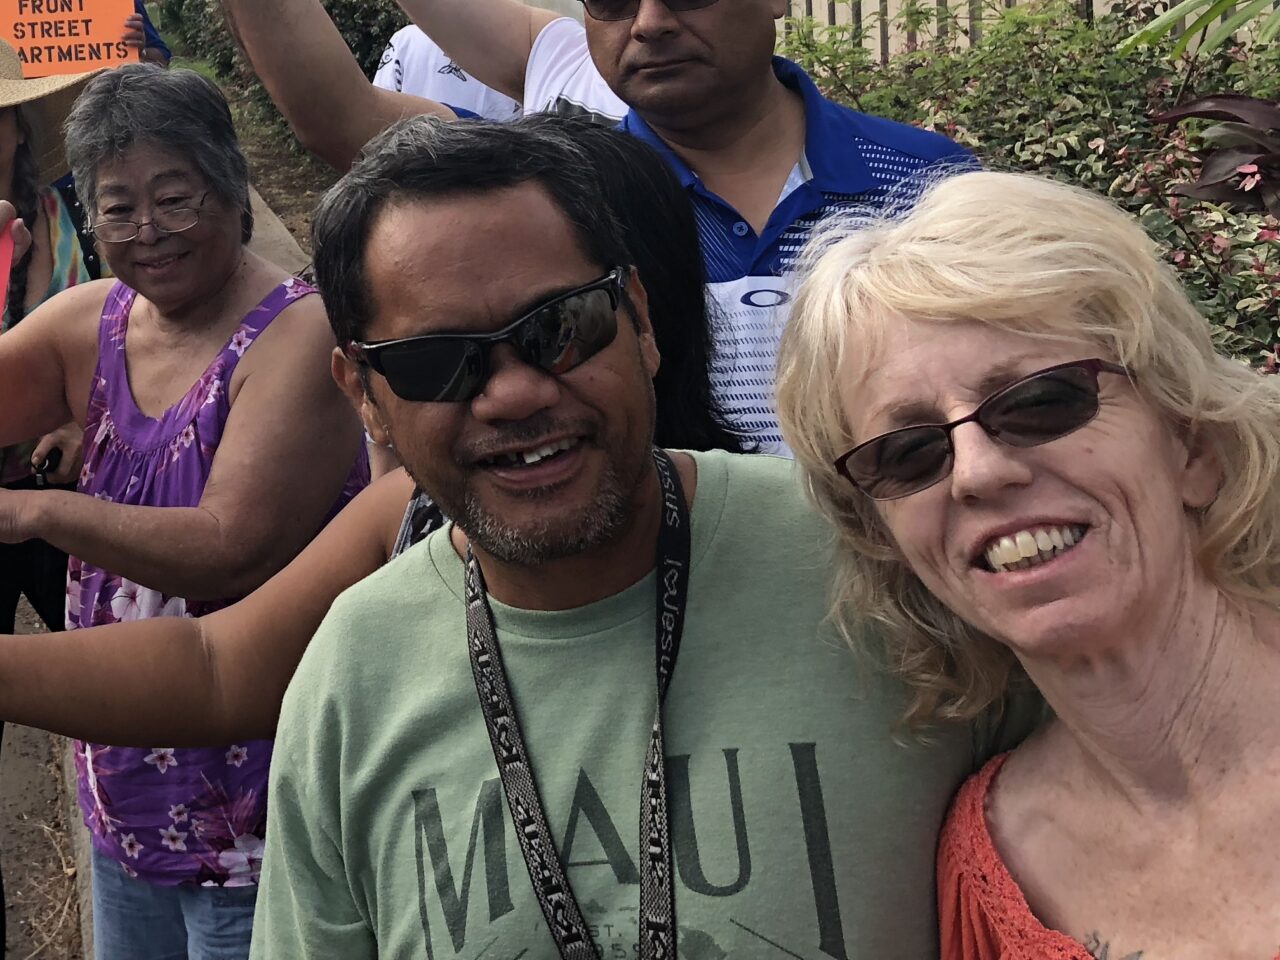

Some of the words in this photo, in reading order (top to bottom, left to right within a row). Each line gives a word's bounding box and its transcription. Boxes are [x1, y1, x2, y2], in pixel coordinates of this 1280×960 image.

[13, 19, 93, 39] STREET
[19, 41, 128, 64] ARTMENTS
[411, 742, 849, 960] MAUI
